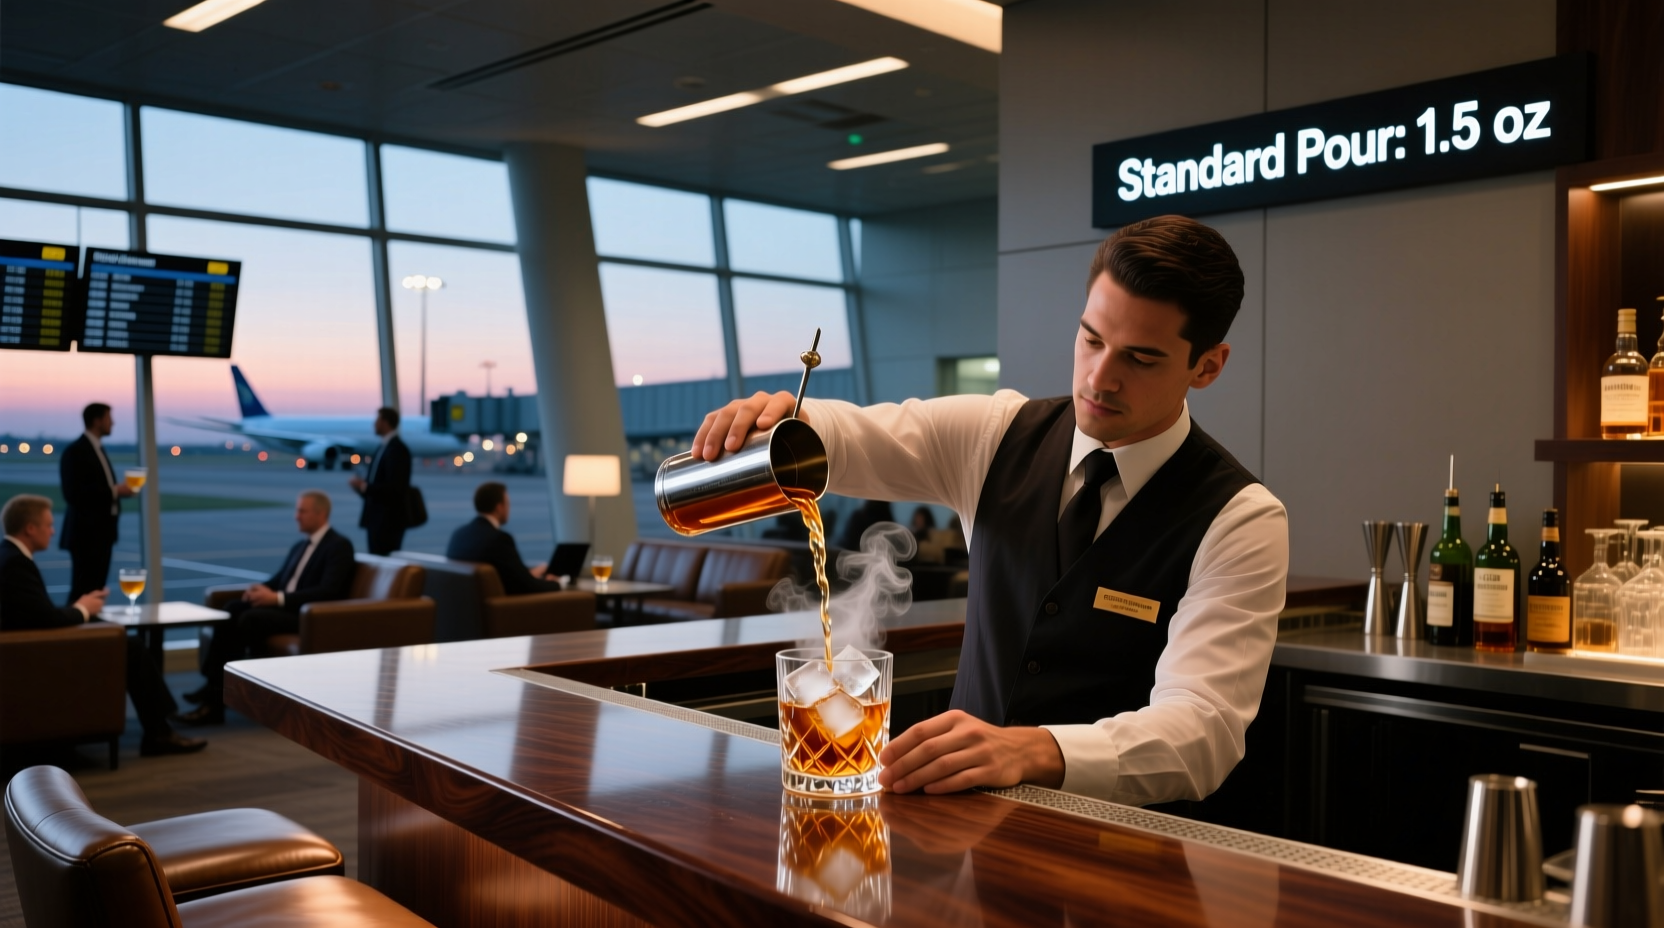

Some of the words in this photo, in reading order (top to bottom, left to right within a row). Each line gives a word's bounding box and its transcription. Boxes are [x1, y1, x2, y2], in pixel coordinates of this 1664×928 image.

[1117, 132, 1286, 202] Standard
[1297, 124, 1406, 175] Pour:
[1416, 99, 1481, 155] 1.5
[1493, 100, 1552, 144] oz
